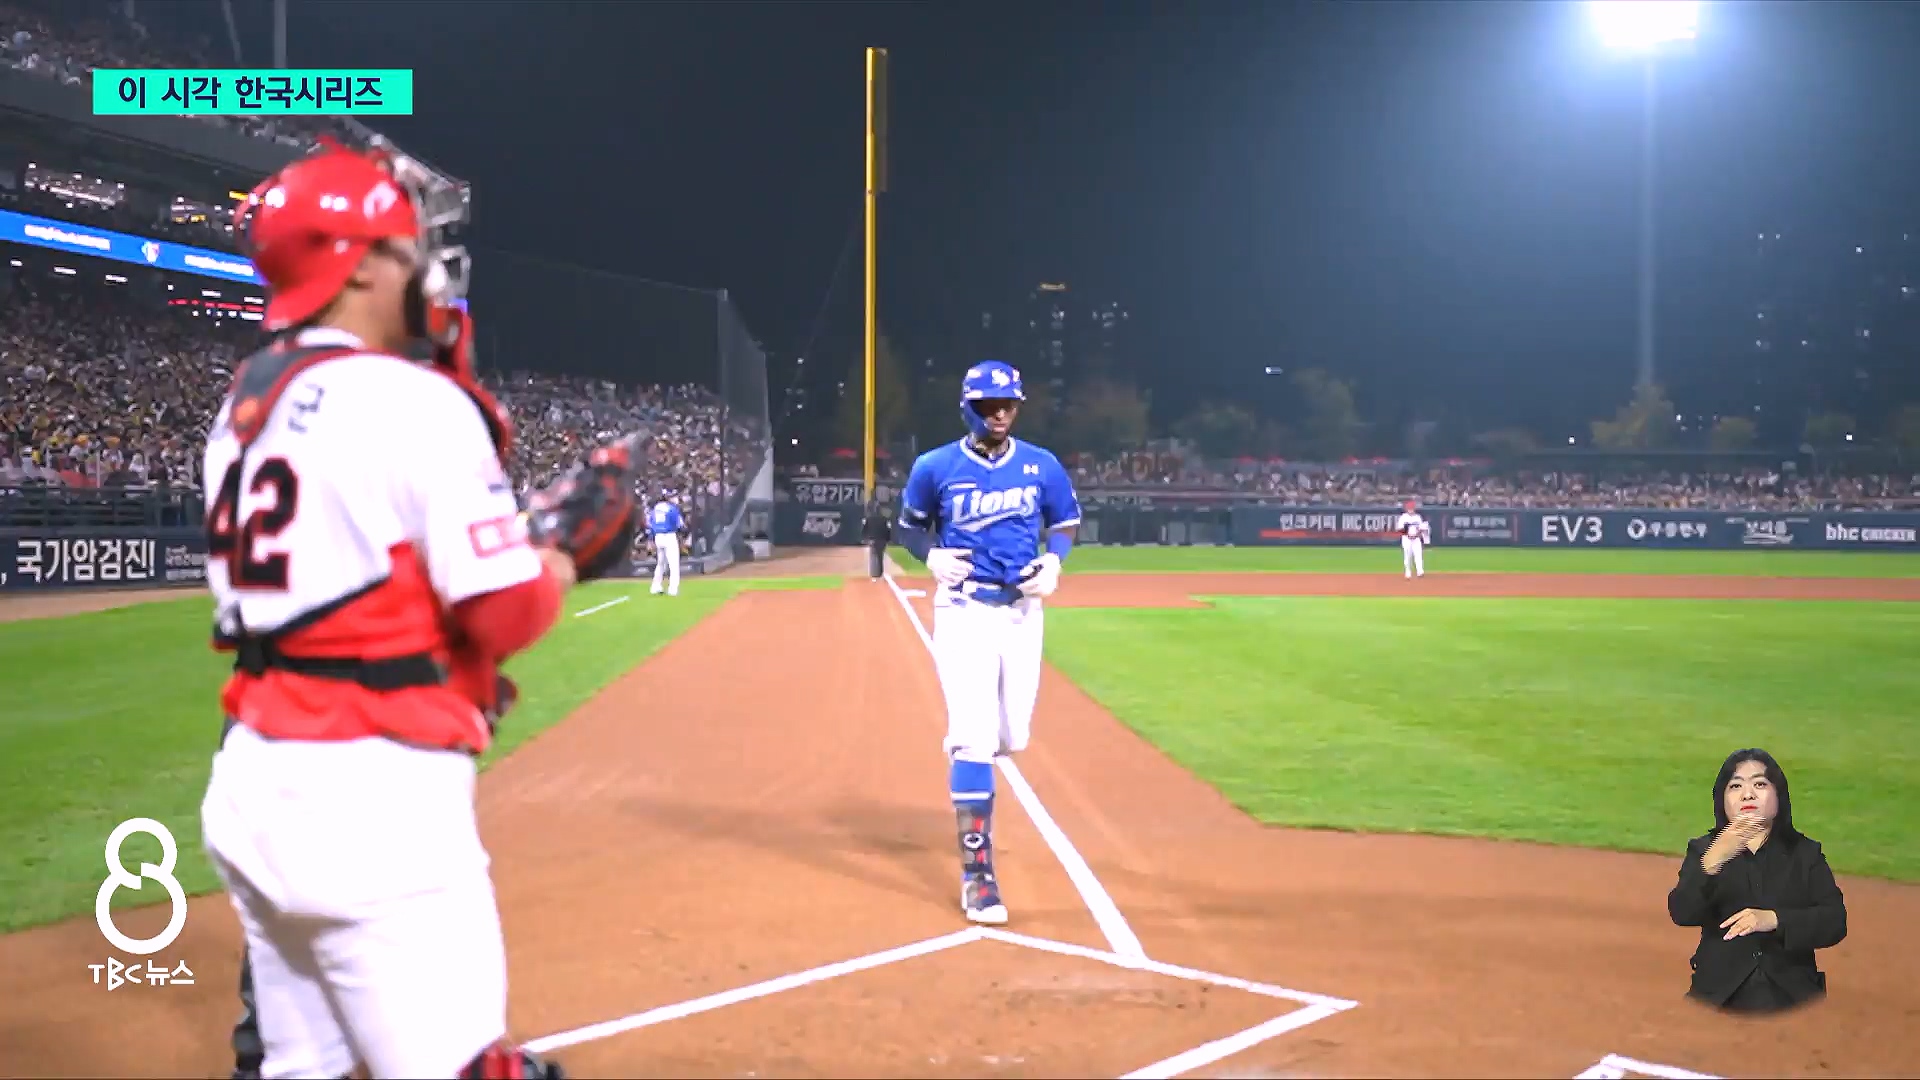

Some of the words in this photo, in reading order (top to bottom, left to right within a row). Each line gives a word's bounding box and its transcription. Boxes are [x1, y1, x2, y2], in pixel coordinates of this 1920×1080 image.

[208, 456, 299, 594] 42
[951, 484, 1040, 526] Lions
[1541, 514, 1603, 543] EV3
[1825, 521, 1860, 541] bhc
[16, 537, 157, 584] 국가암검진!
